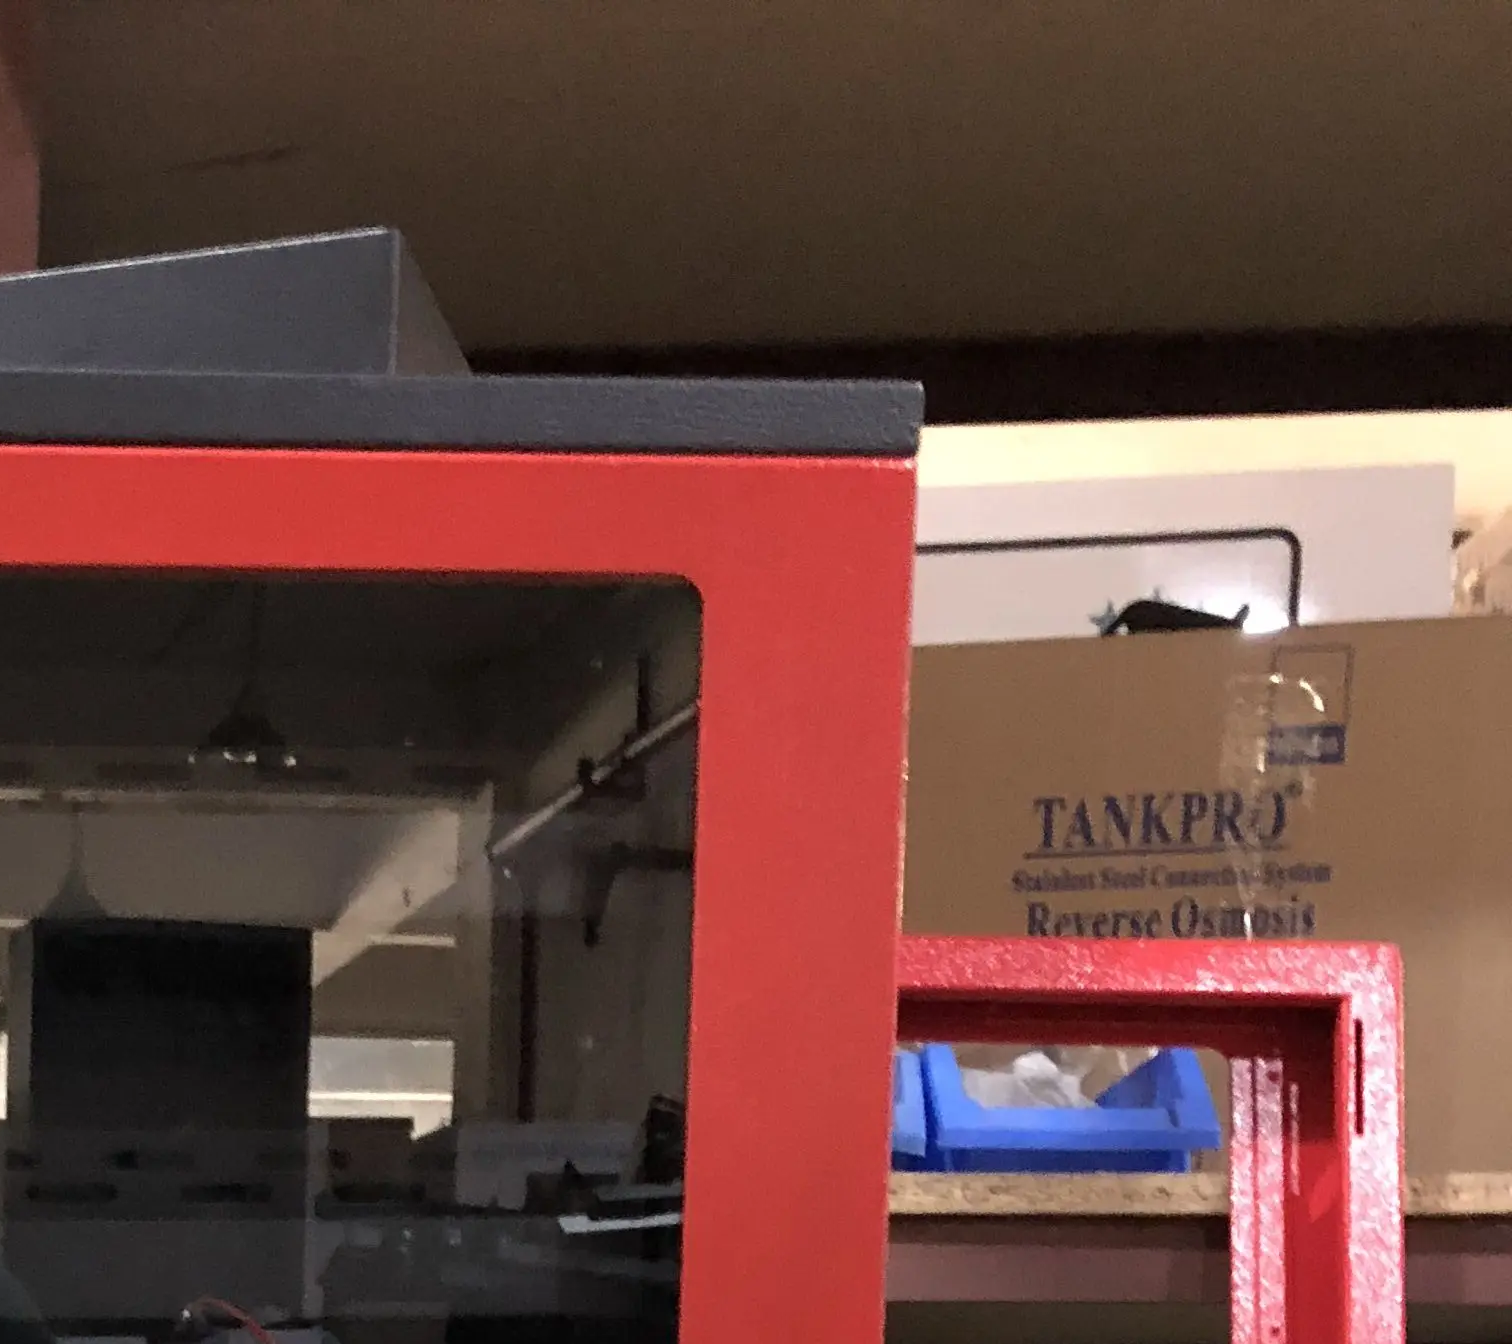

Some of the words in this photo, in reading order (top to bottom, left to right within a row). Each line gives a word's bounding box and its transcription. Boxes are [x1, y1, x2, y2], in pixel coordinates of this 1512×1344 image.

[1033, 786, 1288, 851] TANKPRO
[1026, 900, 1163, 938] Reverse
[1170, 894, 1316, 938] Osmosis
